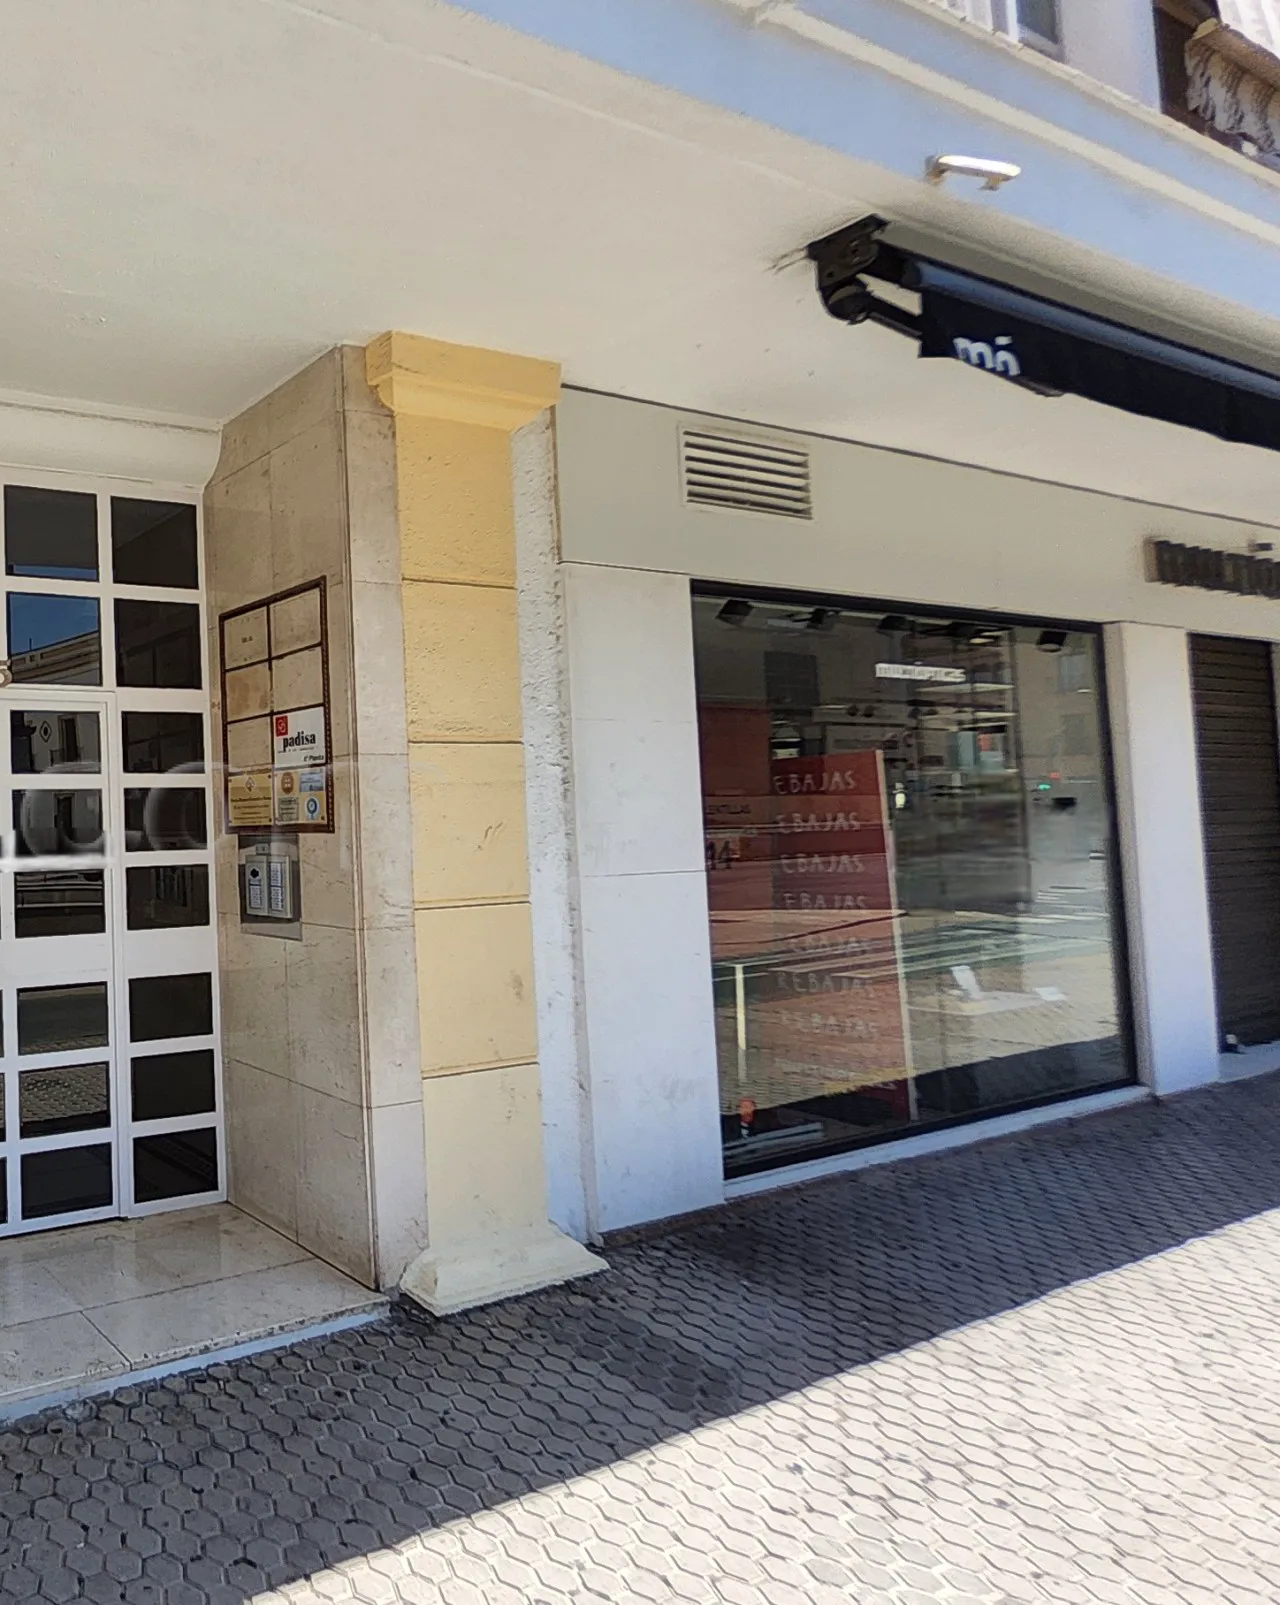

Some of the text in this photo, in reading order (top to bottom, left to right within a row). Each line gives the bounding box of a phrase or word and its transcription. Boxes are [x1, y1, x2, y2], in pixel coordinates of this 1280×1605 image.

[283, 731, 316, 753] padisa
[773, 770, 858, 794] EBAJAS
[775, 812, 861, 833] EBAJAS
[780, 853, 866, 873] EBAJAS
[783, 892, 868, 909] EBAJAS
